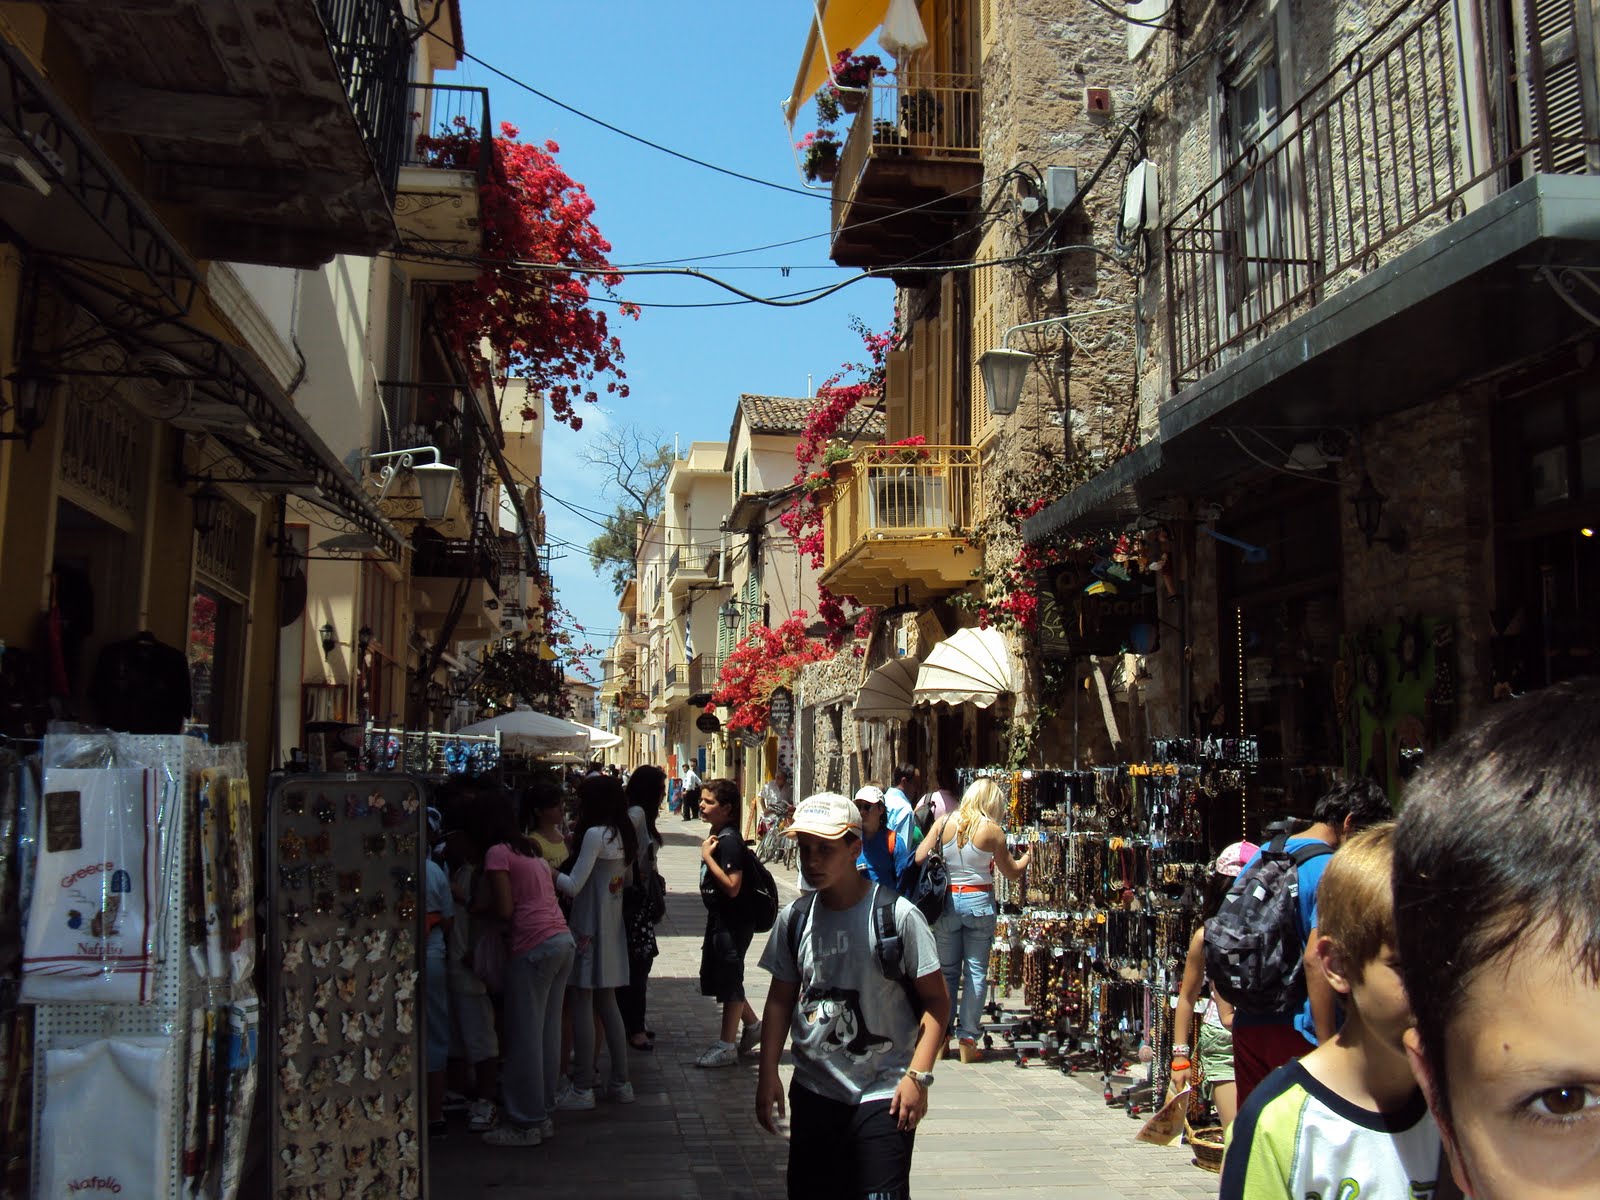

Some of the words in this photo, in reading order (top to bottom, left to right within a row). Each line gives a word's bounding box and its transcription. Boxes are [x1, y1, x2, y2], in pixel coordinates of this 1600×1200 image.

[61, 862, 114, 888] Greece
[77, 942, 123, 957] Nafplio
[68, 1176, 122, 1193] Nafplio
